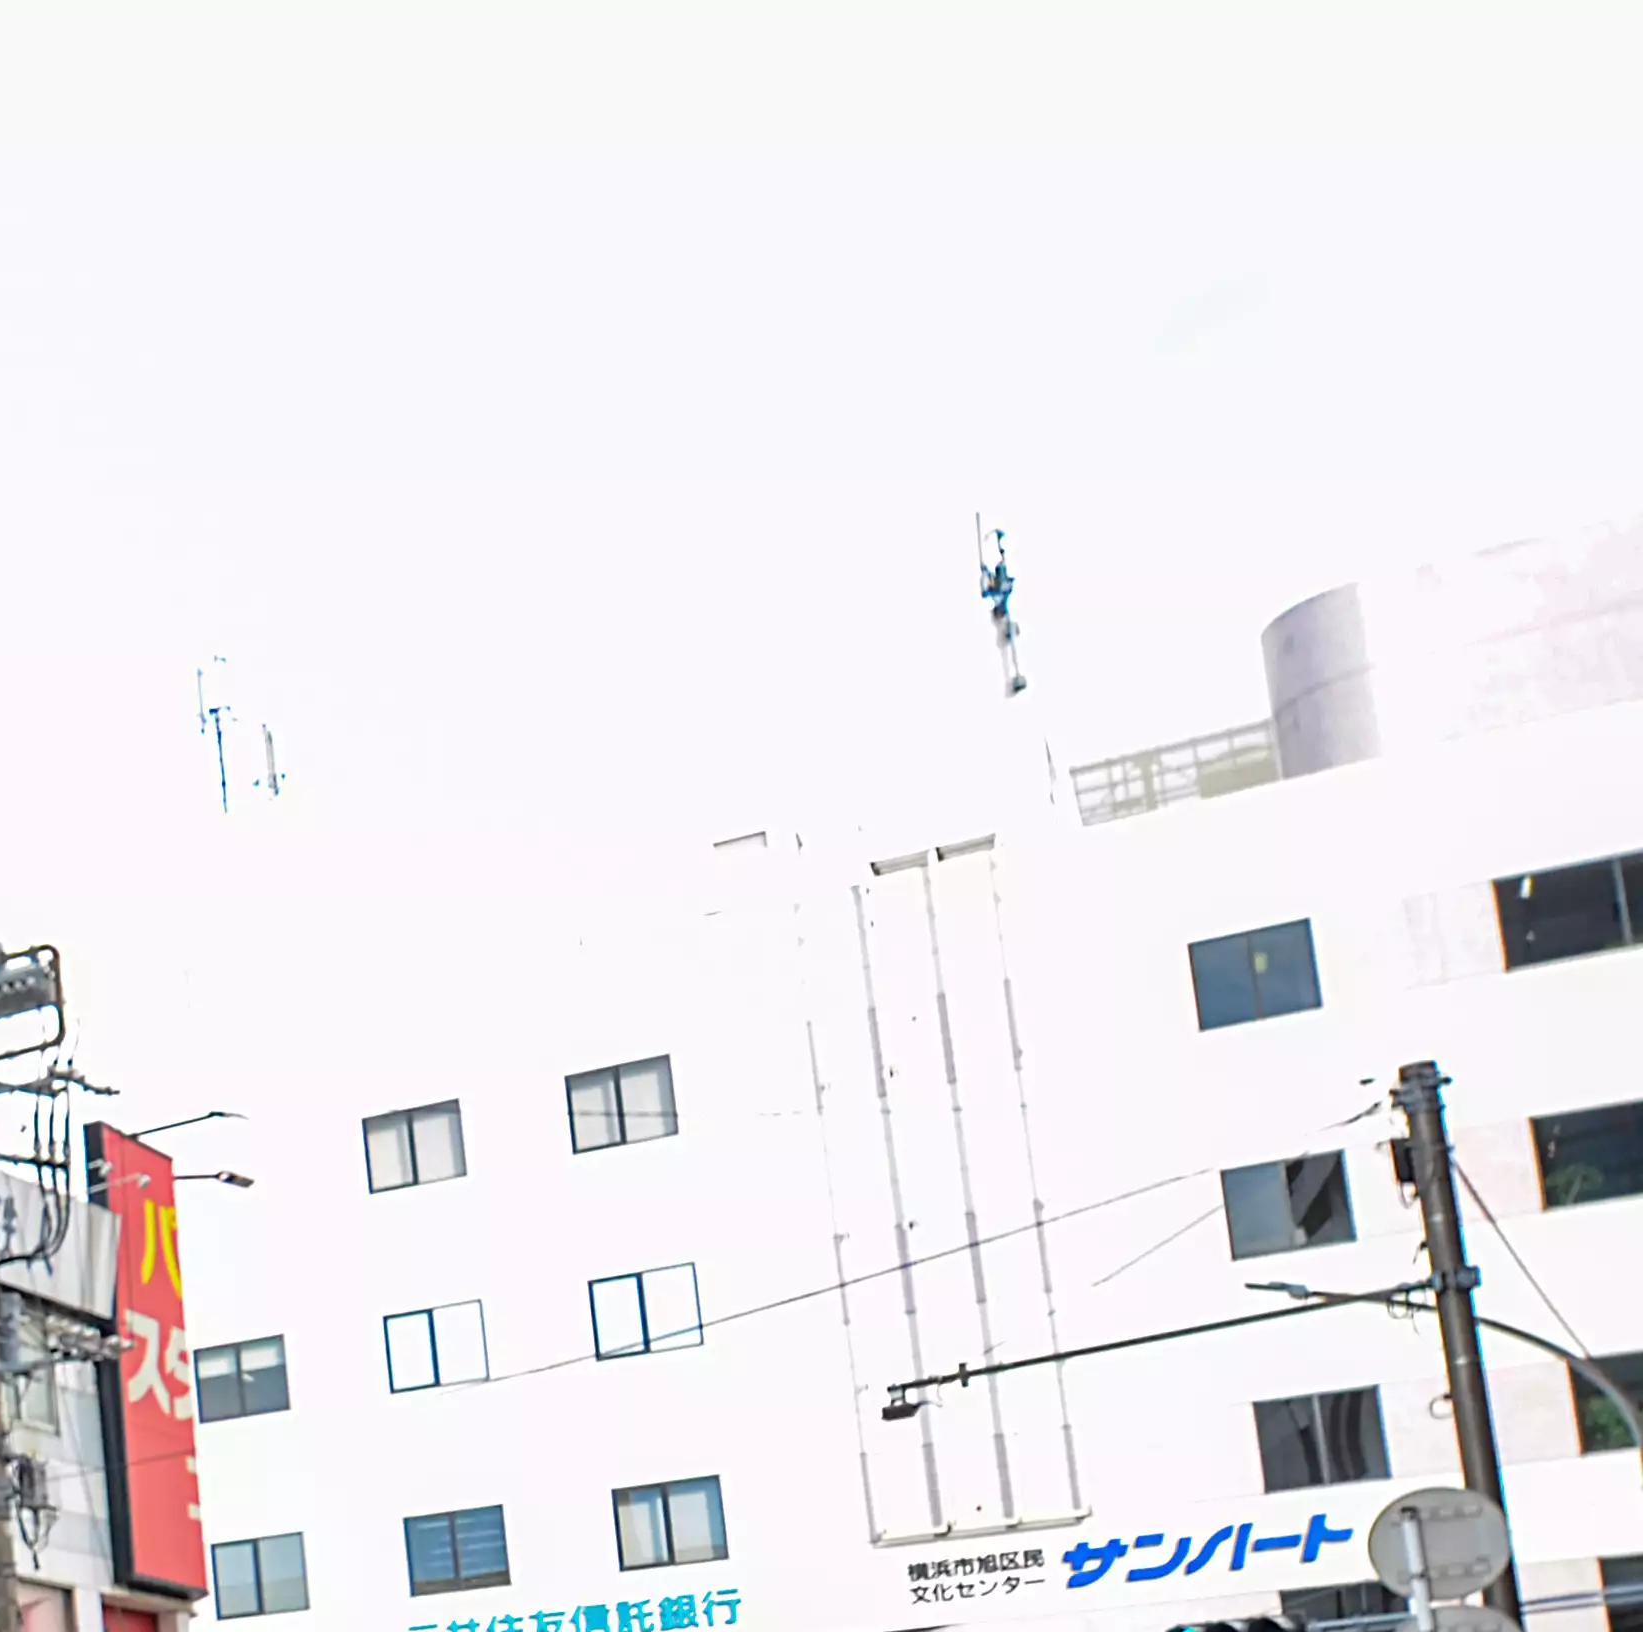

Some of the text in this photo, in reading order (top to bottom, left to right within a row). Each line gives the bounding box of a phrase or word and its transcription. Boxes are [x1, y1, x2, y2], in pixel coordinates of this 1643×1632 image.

[908, 1548, 1045, 1582] 横浜市旭区民
[1061, 1513, 1354, 1590] サンハート
[909, 1576, 1046, 1605] 文化センター
